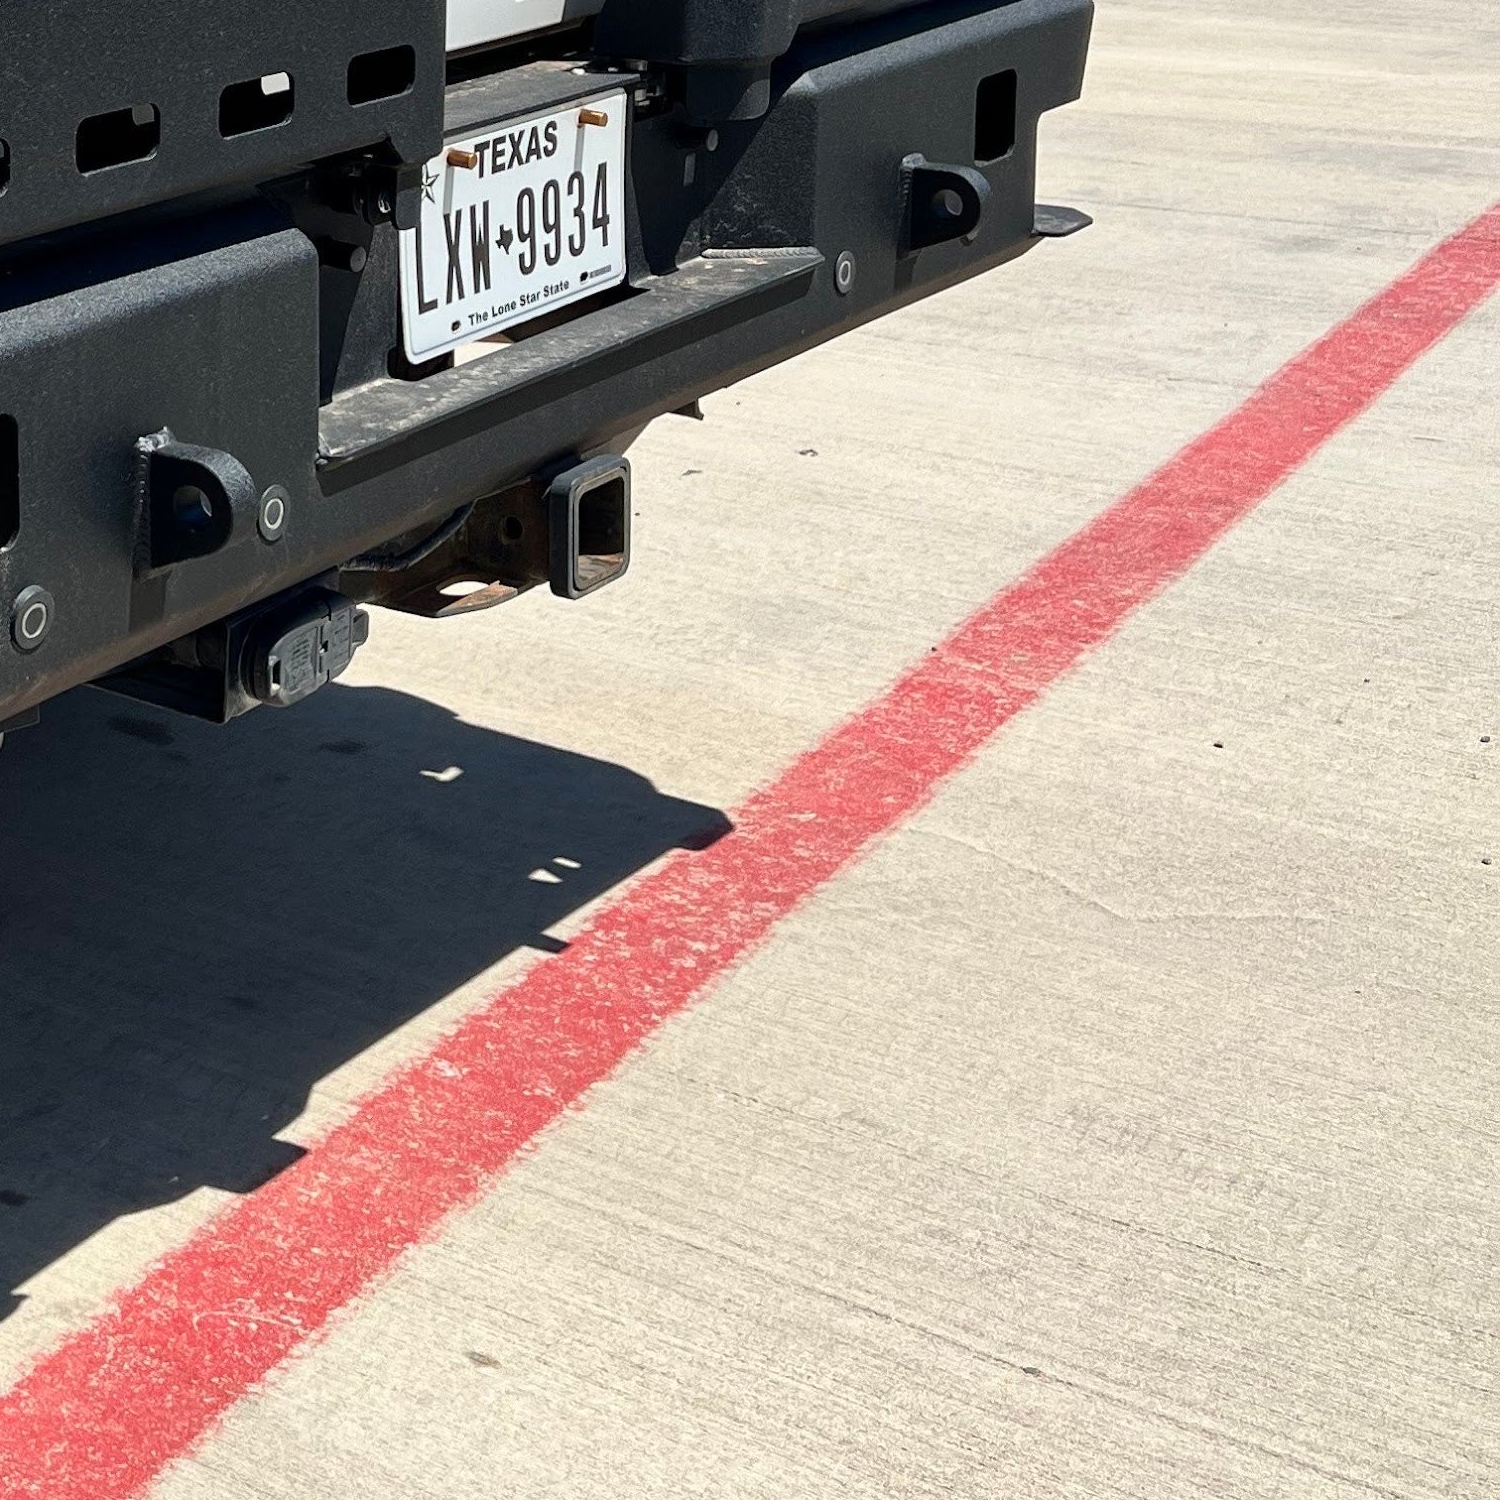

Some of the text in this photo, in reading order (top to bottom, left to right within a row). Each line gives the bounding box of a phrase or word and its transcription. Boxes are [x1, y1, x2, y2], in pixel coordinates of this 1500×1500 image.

[474, 120, 558, 179] TEXAS
[468, 280, 570, 326] The Lone Star State
